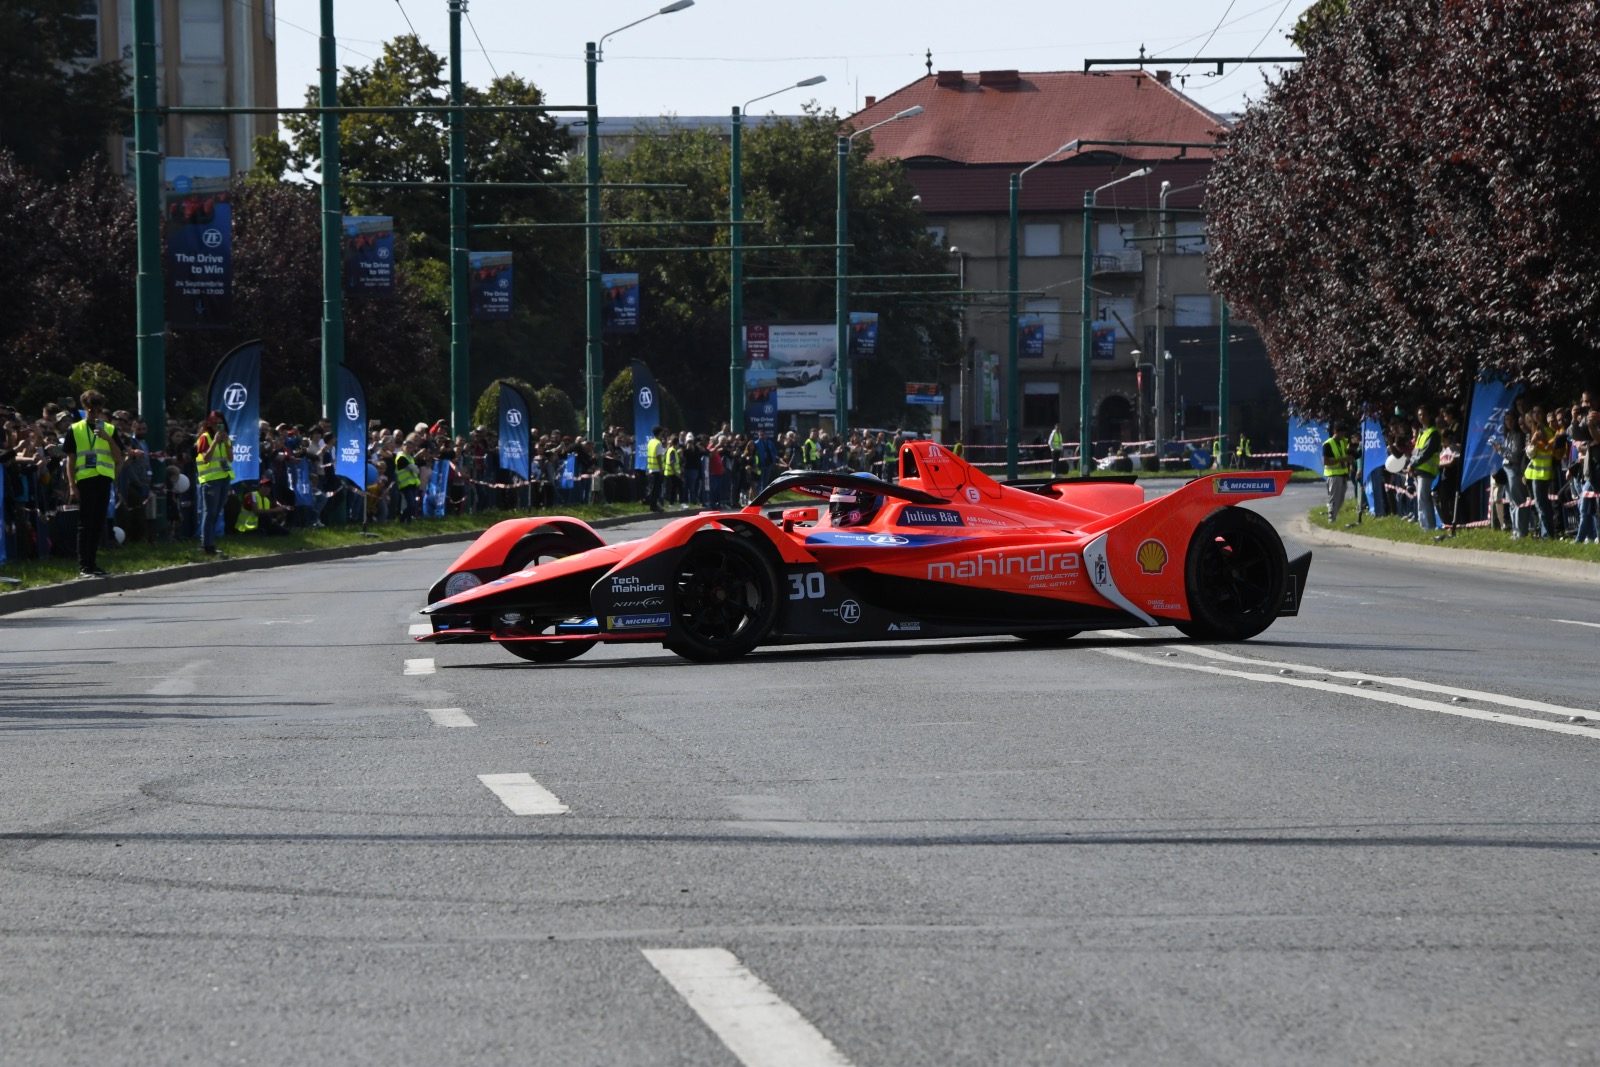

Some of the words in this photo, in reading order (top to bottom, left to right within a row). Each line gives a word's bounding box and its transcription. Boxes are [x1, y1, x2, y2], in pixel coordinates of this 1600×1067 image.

[175, 253, 195, 262] The
[197, 253, 224, 262] Drive
[191, 265, 202, 274] to
[204, 265, 224, 274] Win
[224, 386, 247, 407] ZF
[232, 444, 252, 453] tor
[1365, 438, 1381, 450] port
[233, 453, 252, 462] ort
[905, 510, 937, 523] Julius
[939, 511, 958, 522] Bär
[868, 535, 909, 544] ZF
[927, 550, 1080, 579] mahindra
[611, 576, 639, 584] Tech
[612, 584, 664, 592] Mahindra
[788, 571, 825, 600] 30
[612, 597, 664, 608] NIPPON
[840, 603, 860, 620] ZF
